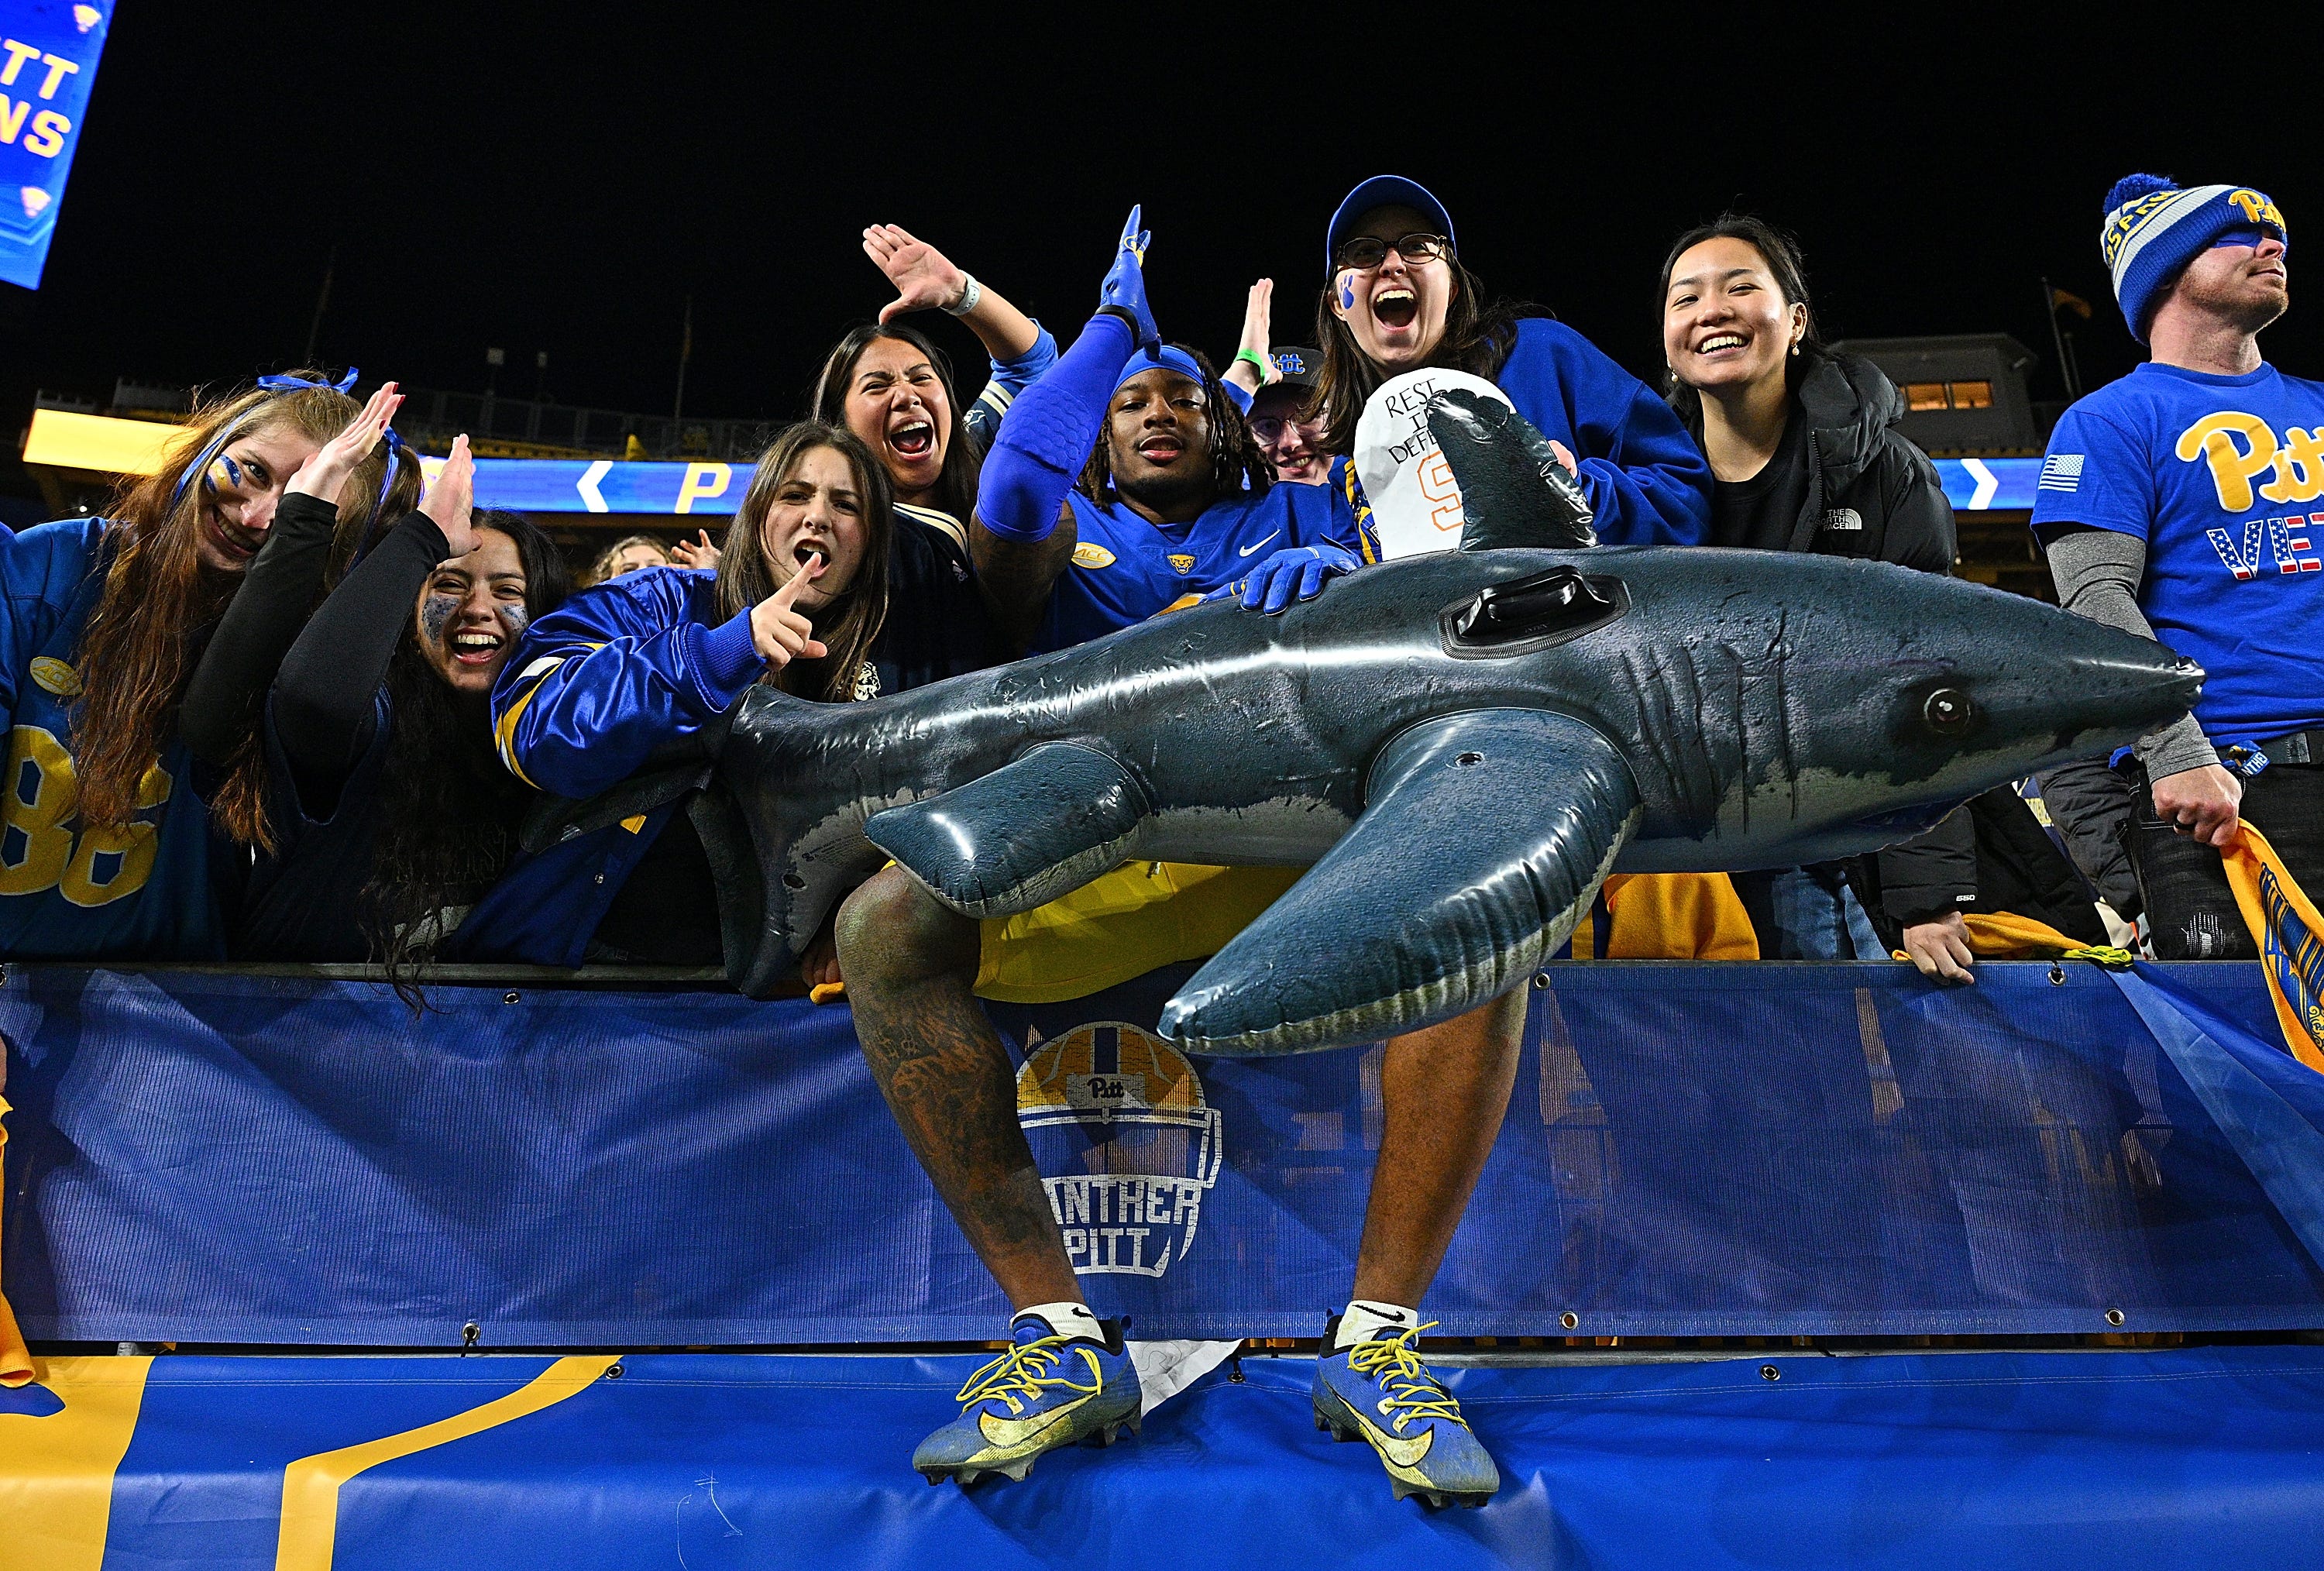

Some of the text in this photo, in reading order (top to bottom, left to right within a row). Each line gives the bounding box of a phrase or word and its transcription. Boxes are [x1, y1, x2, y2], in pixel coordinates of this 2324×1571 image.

[0, 37, 79, 100] TT
[0, 92, 71, 158] NS
[1385, 378, 1435, 418] REST
[675, 462, 732, 514] P
[1820, 515, 1844, 524] ORTH
[1824, 522, 1845, 531] FACE
[1074, 548, 1109, 562] ACC
[1087, 1078, 1124, 1098] Pitt
[1064, 1228, 1151, 1270] PITT
